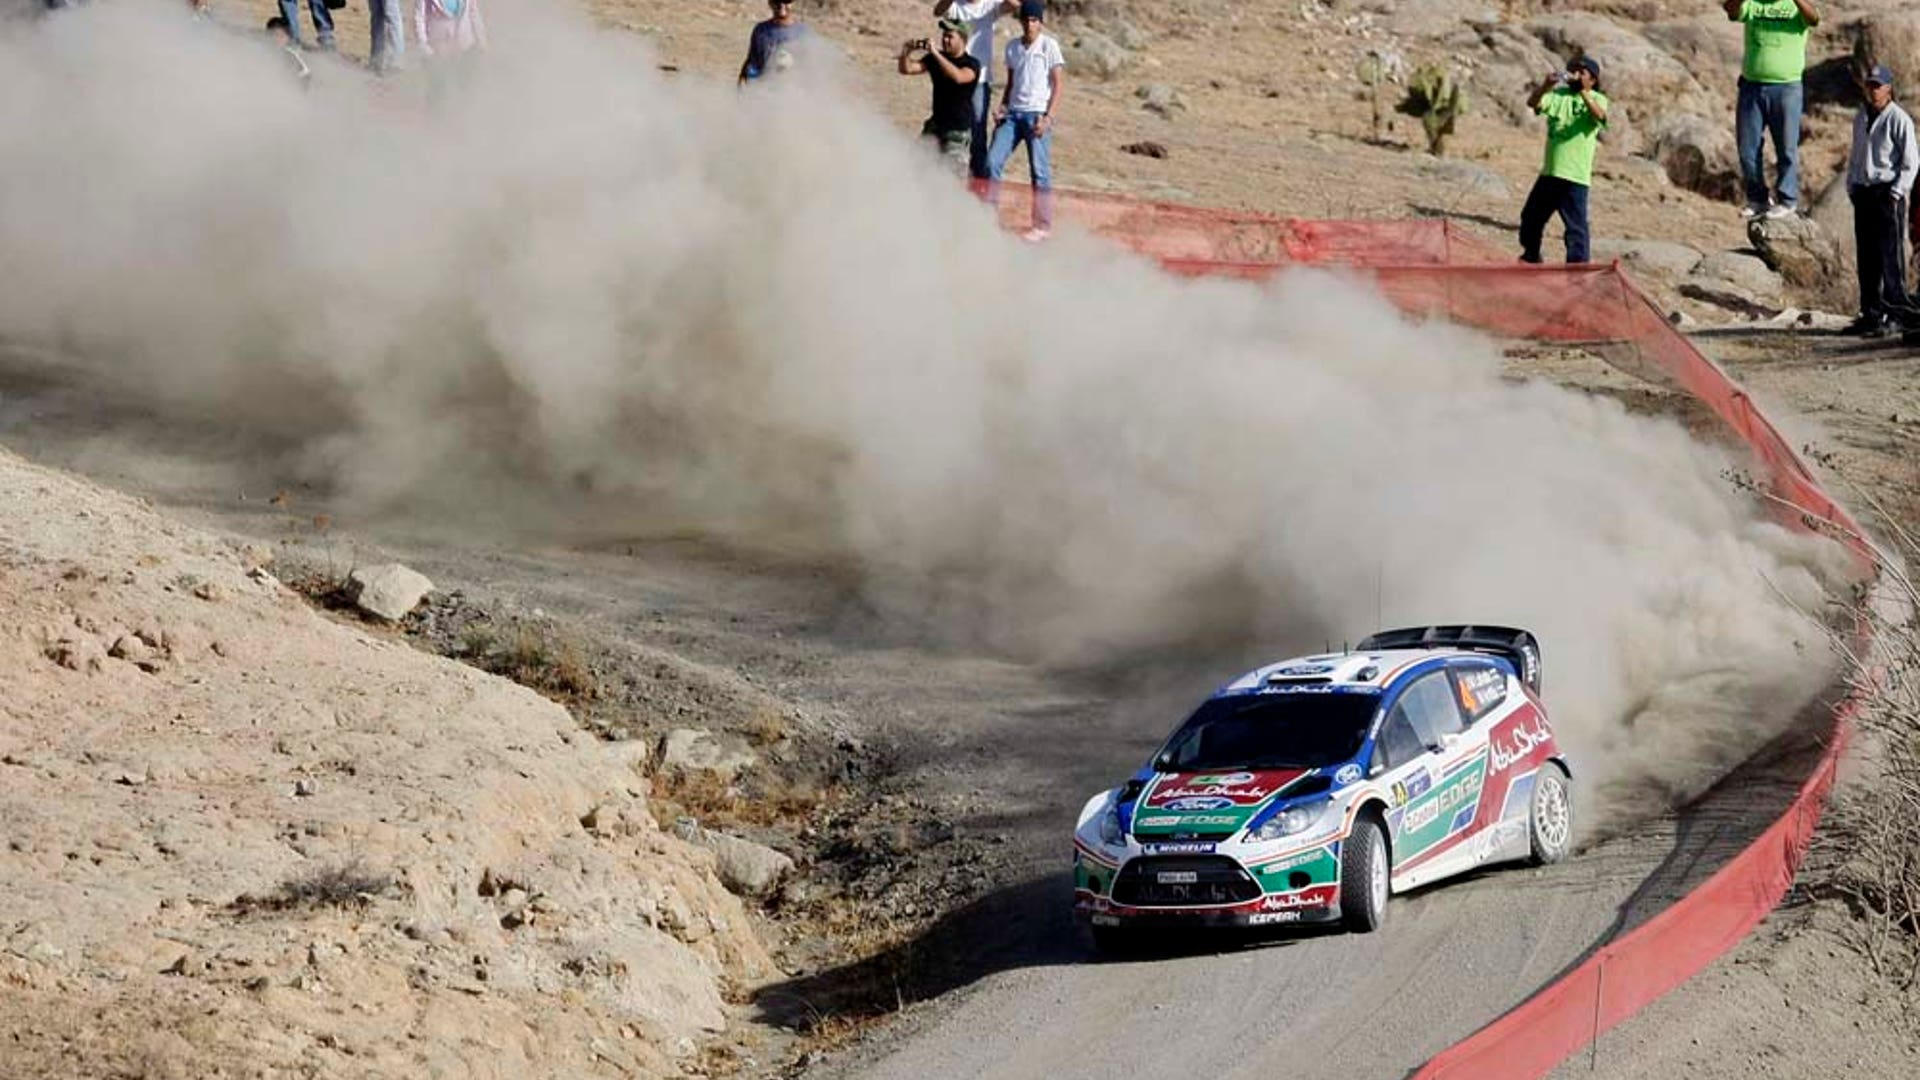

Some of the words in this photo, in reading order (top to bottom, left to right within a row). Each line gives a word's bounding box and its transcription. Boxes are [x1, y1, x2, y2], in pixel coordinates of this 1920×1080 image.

[1458, 679, 1477, 710] 4
[1440, 769, 1480, 812] EDGE
[1181, 816, 1238, 825] EDGE
[1160, 843, 1214, 853] MICHELIN
[1249, 911, 1301, 924] ICEPEAK
